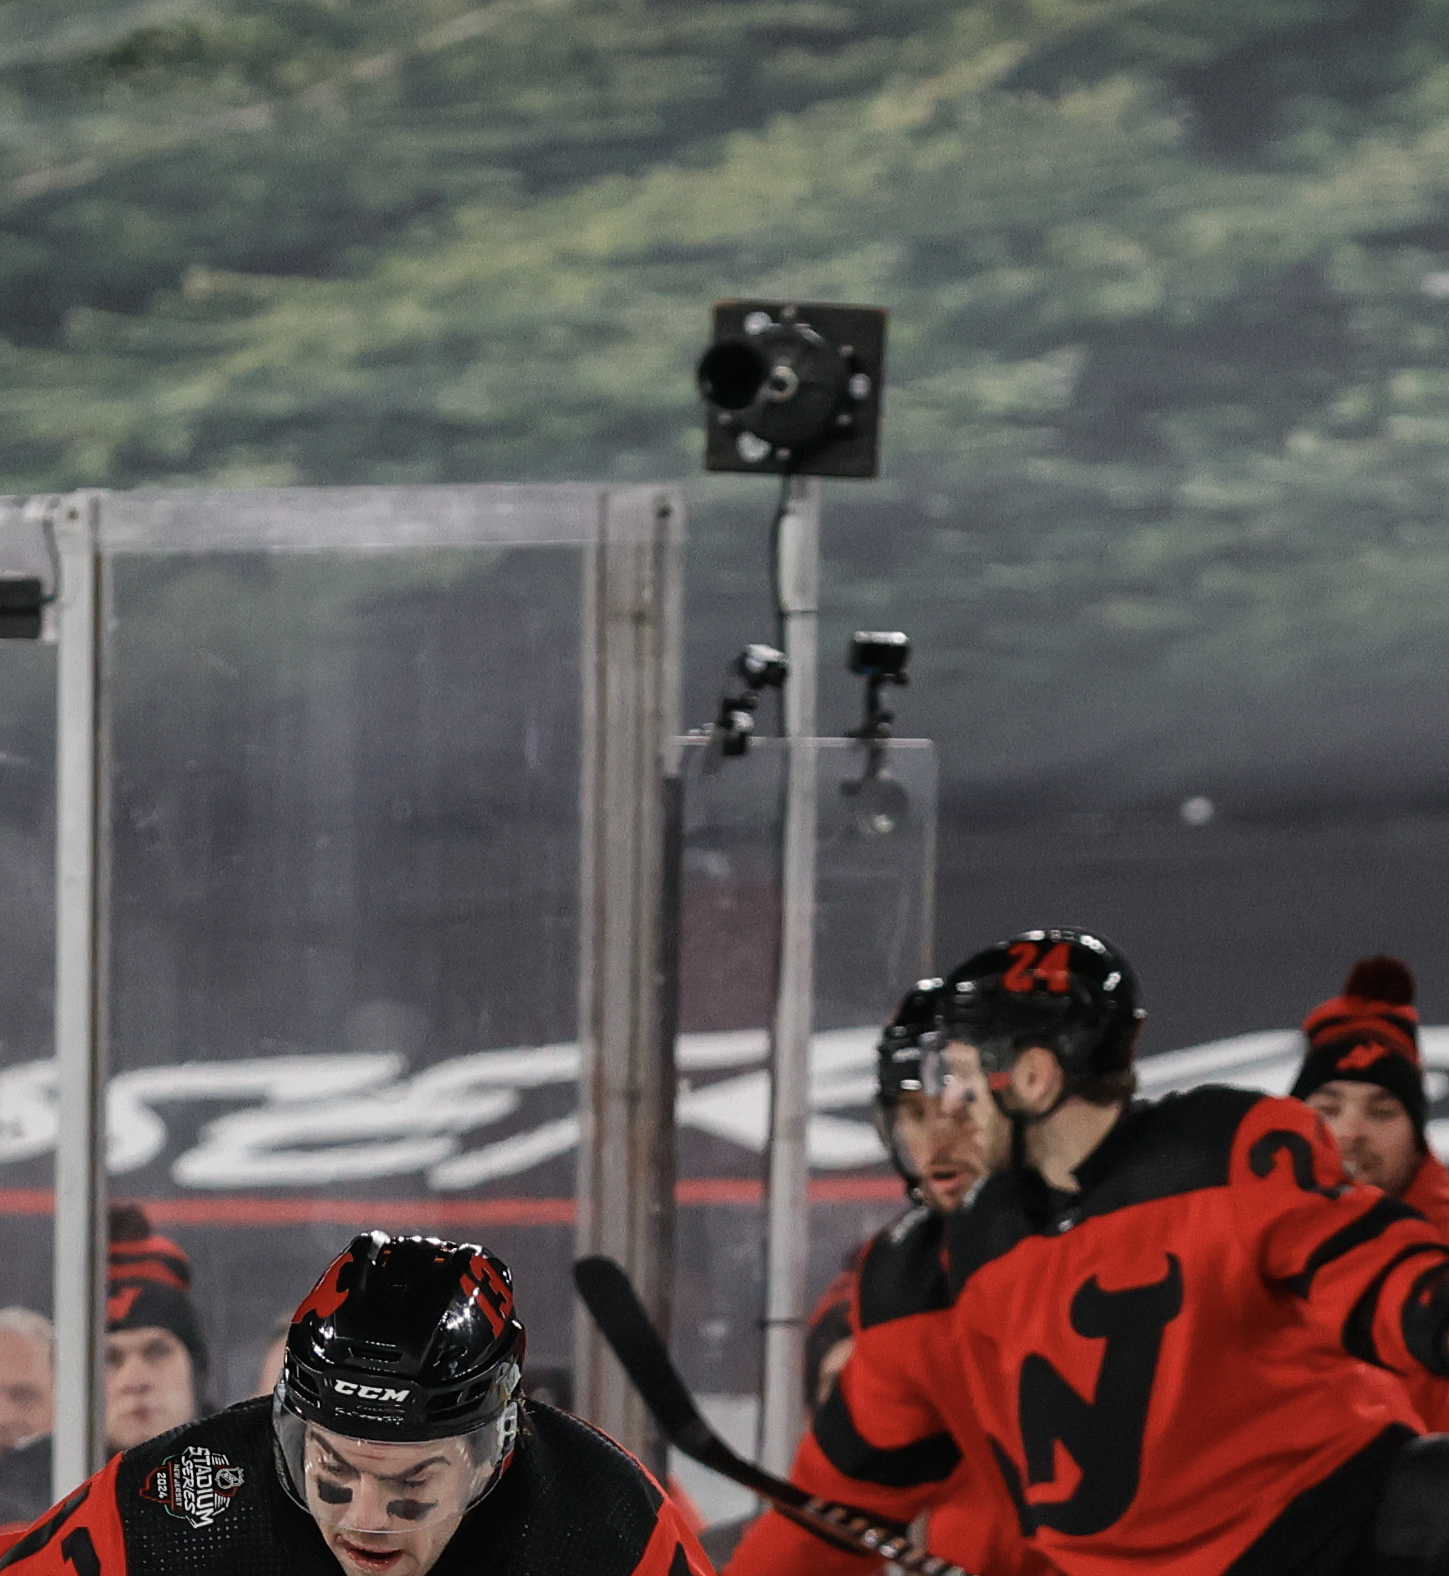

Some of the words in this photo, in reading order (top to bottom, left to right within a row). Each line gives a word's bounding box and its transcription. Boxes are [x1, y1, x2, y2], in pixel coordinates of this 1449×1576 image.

[1003, 941, 1071, 994] 24
[459, 1253, 515, 1339] 13
[334, 1379, 410, 1403] CCM
[157, 1472, 168, 1499] 2024
[181, 1455, 196, 1515] SERIES
[187, 1446, 215, 1528] STADIUM
